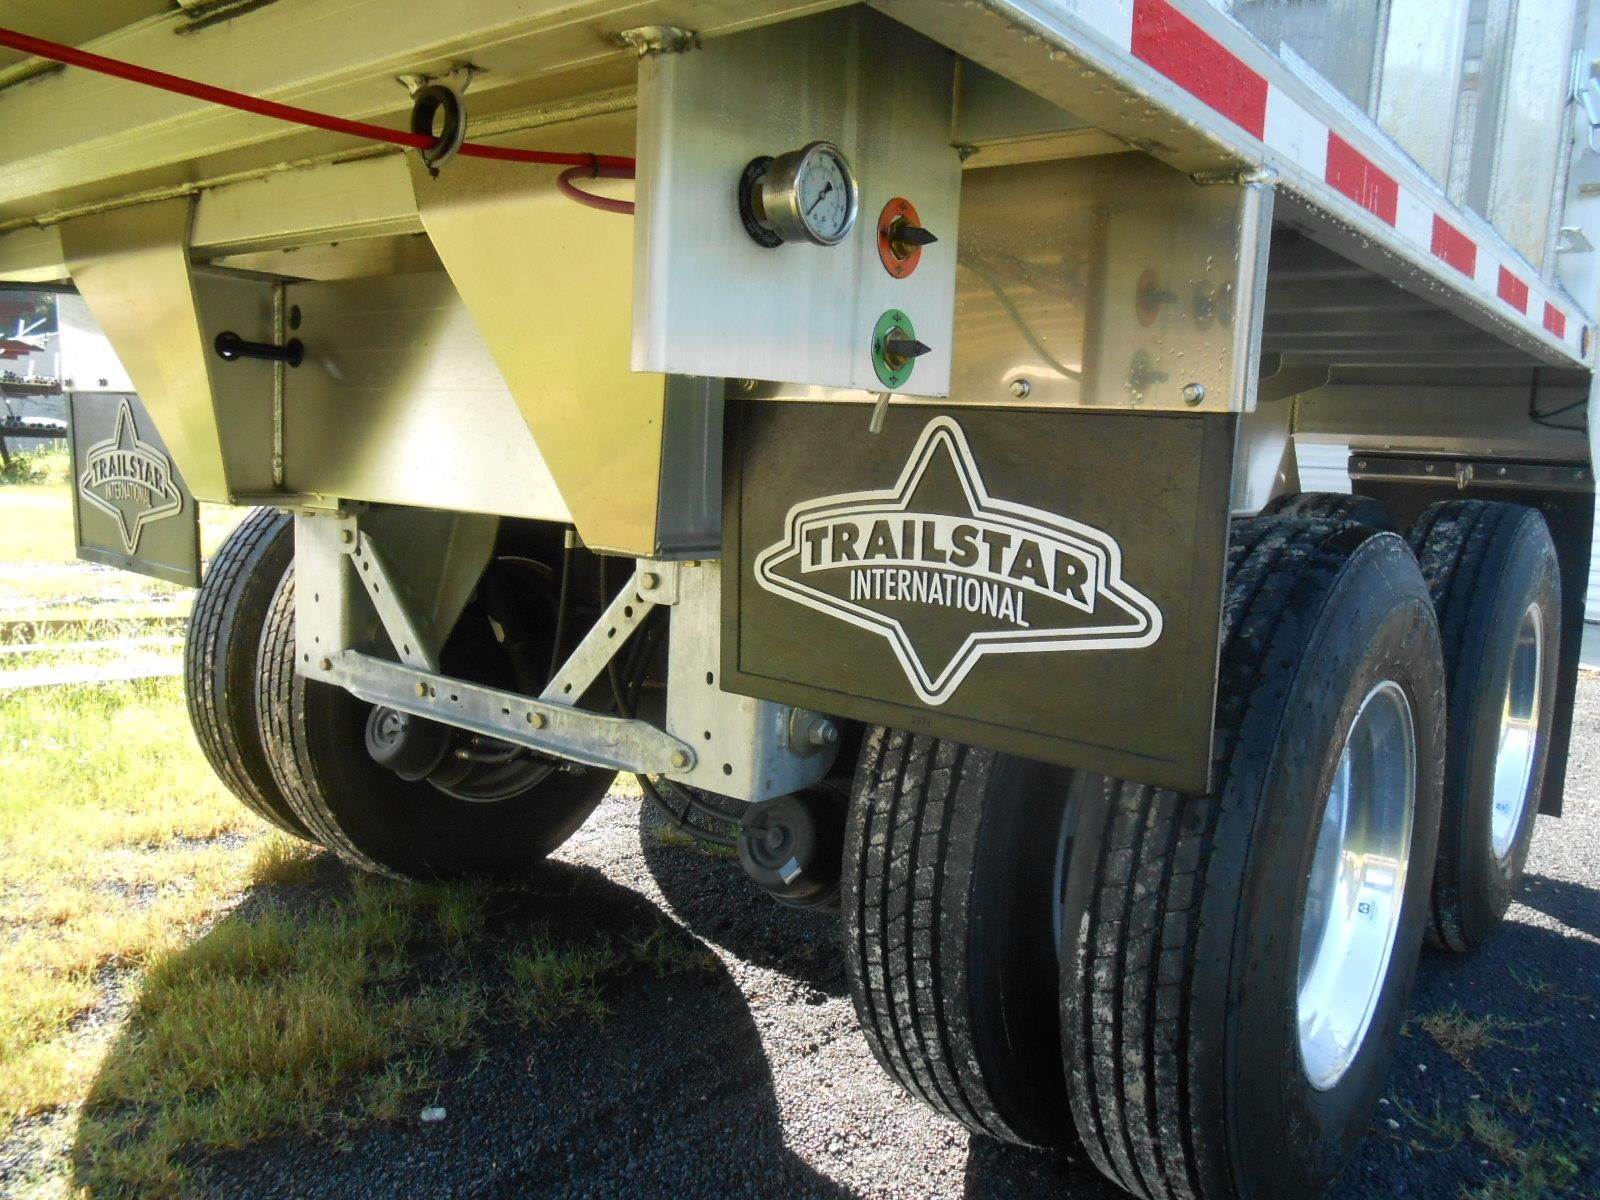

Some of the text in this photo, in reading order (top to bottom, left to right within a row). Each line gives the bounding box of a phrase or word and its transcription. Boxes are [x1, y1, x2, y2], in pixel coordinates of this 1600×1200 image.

[92, 454, 166, 494] TRAILSTAR
[806, 520, 1089, 602] TRAILSTAR
[850, 570, 1029, 627] INTERNATIONAL
